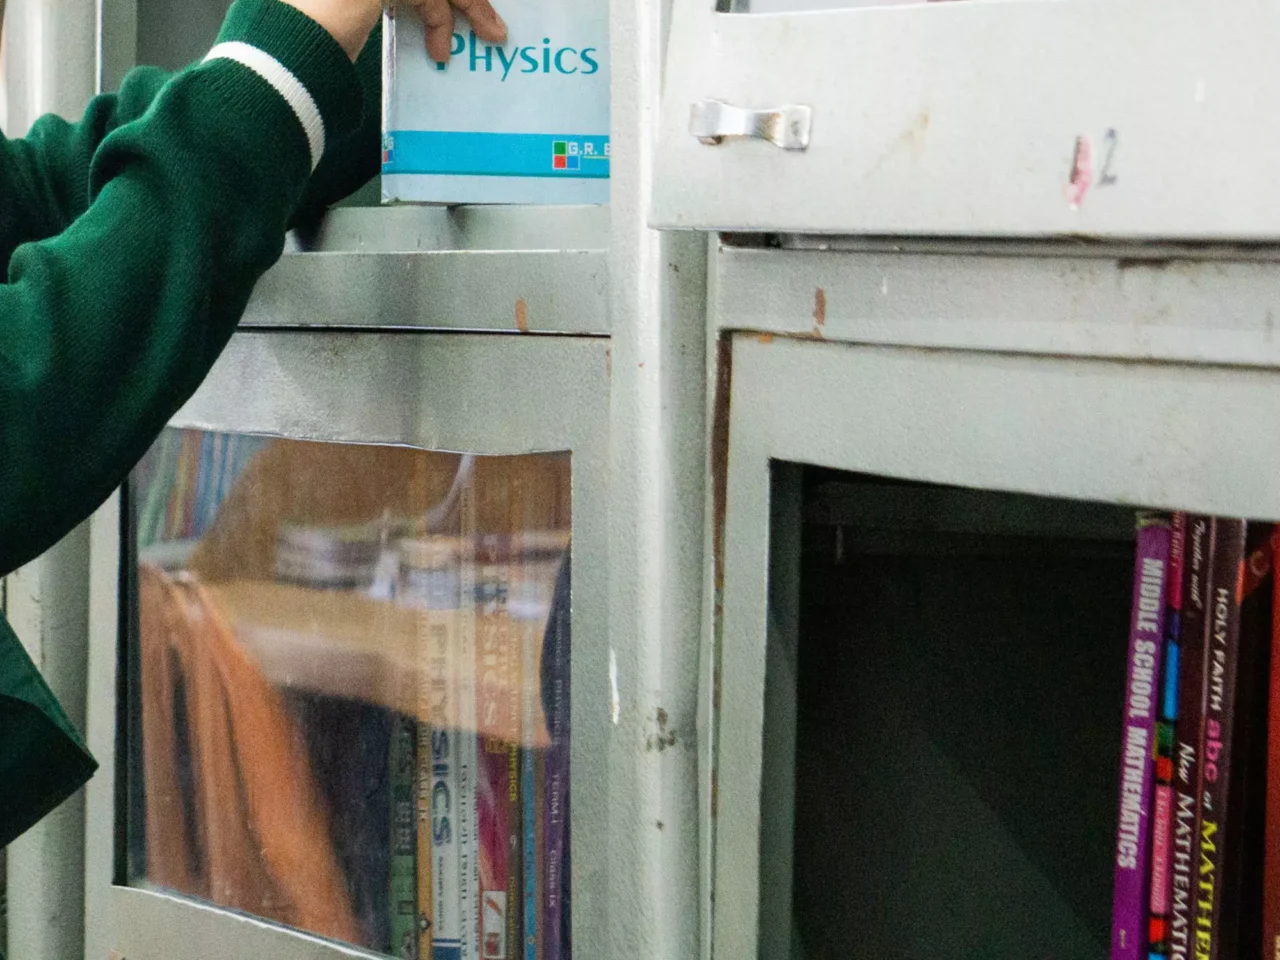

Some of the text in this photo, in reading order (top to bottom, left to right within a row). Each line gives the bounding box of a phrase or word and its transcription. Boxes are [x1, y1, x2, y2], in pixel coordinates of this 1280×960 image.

[435, 30, 599, 82] Physics
[1214, 587, 1229, 645] HOLY
[1209, 649, 1225, 711] FAITH
[430, 623, 454, 848] PHYSICS
[1117, 558, 1164, 870] MIDDLE SCHOOL MATHEMATICS
[1178, 742, 1196, 783] New
[1204, 718, 1223, 784] abc
